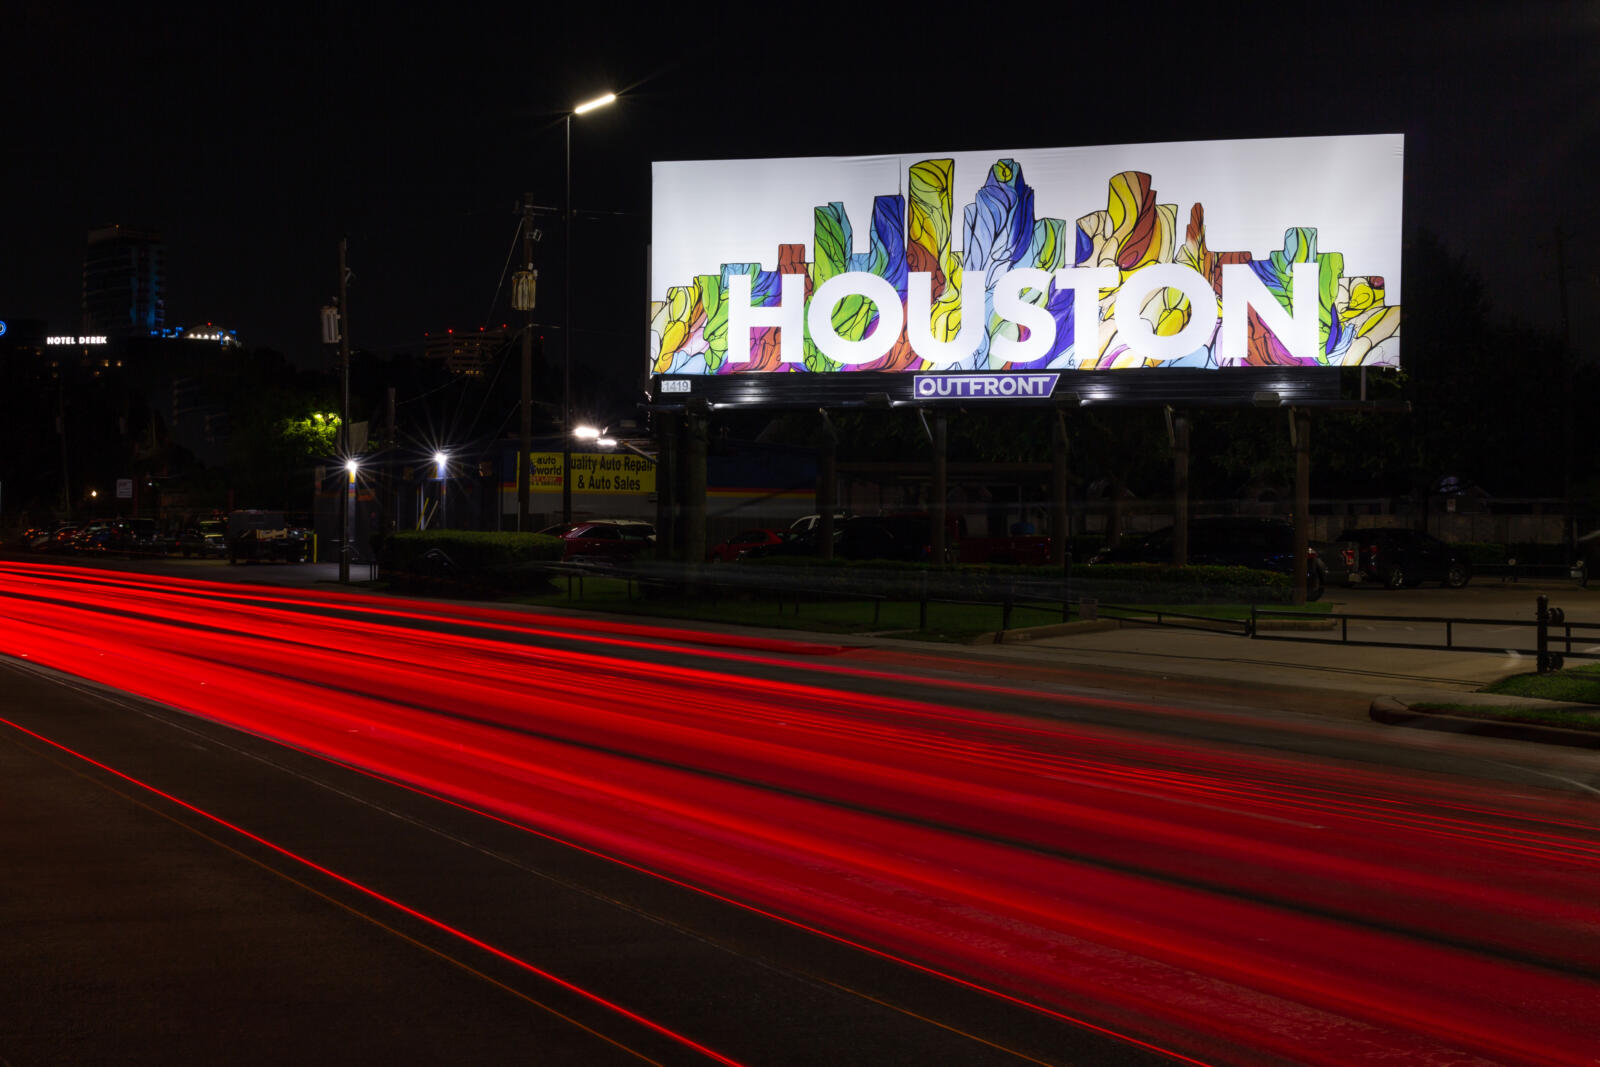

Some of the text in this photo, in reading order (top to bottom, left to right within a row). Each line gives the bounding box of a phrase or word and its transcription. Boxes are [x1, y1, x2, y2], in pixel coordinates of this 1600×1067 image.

[728, 261, 1319, 366] HOUSTON
[46, 336, 107, 345] HOTEL DEREK
[664, 381, 689, 392] 1419
[918, 376, 1050, 396] OUTFRONT
[536, 455, 557, 465] auto
[570, 455, 597, 474] uality
[599, 456, 622, 471] Auto
[535, 464, 562, 475] world
[577, 474, 641, 491] & Auto Sales
